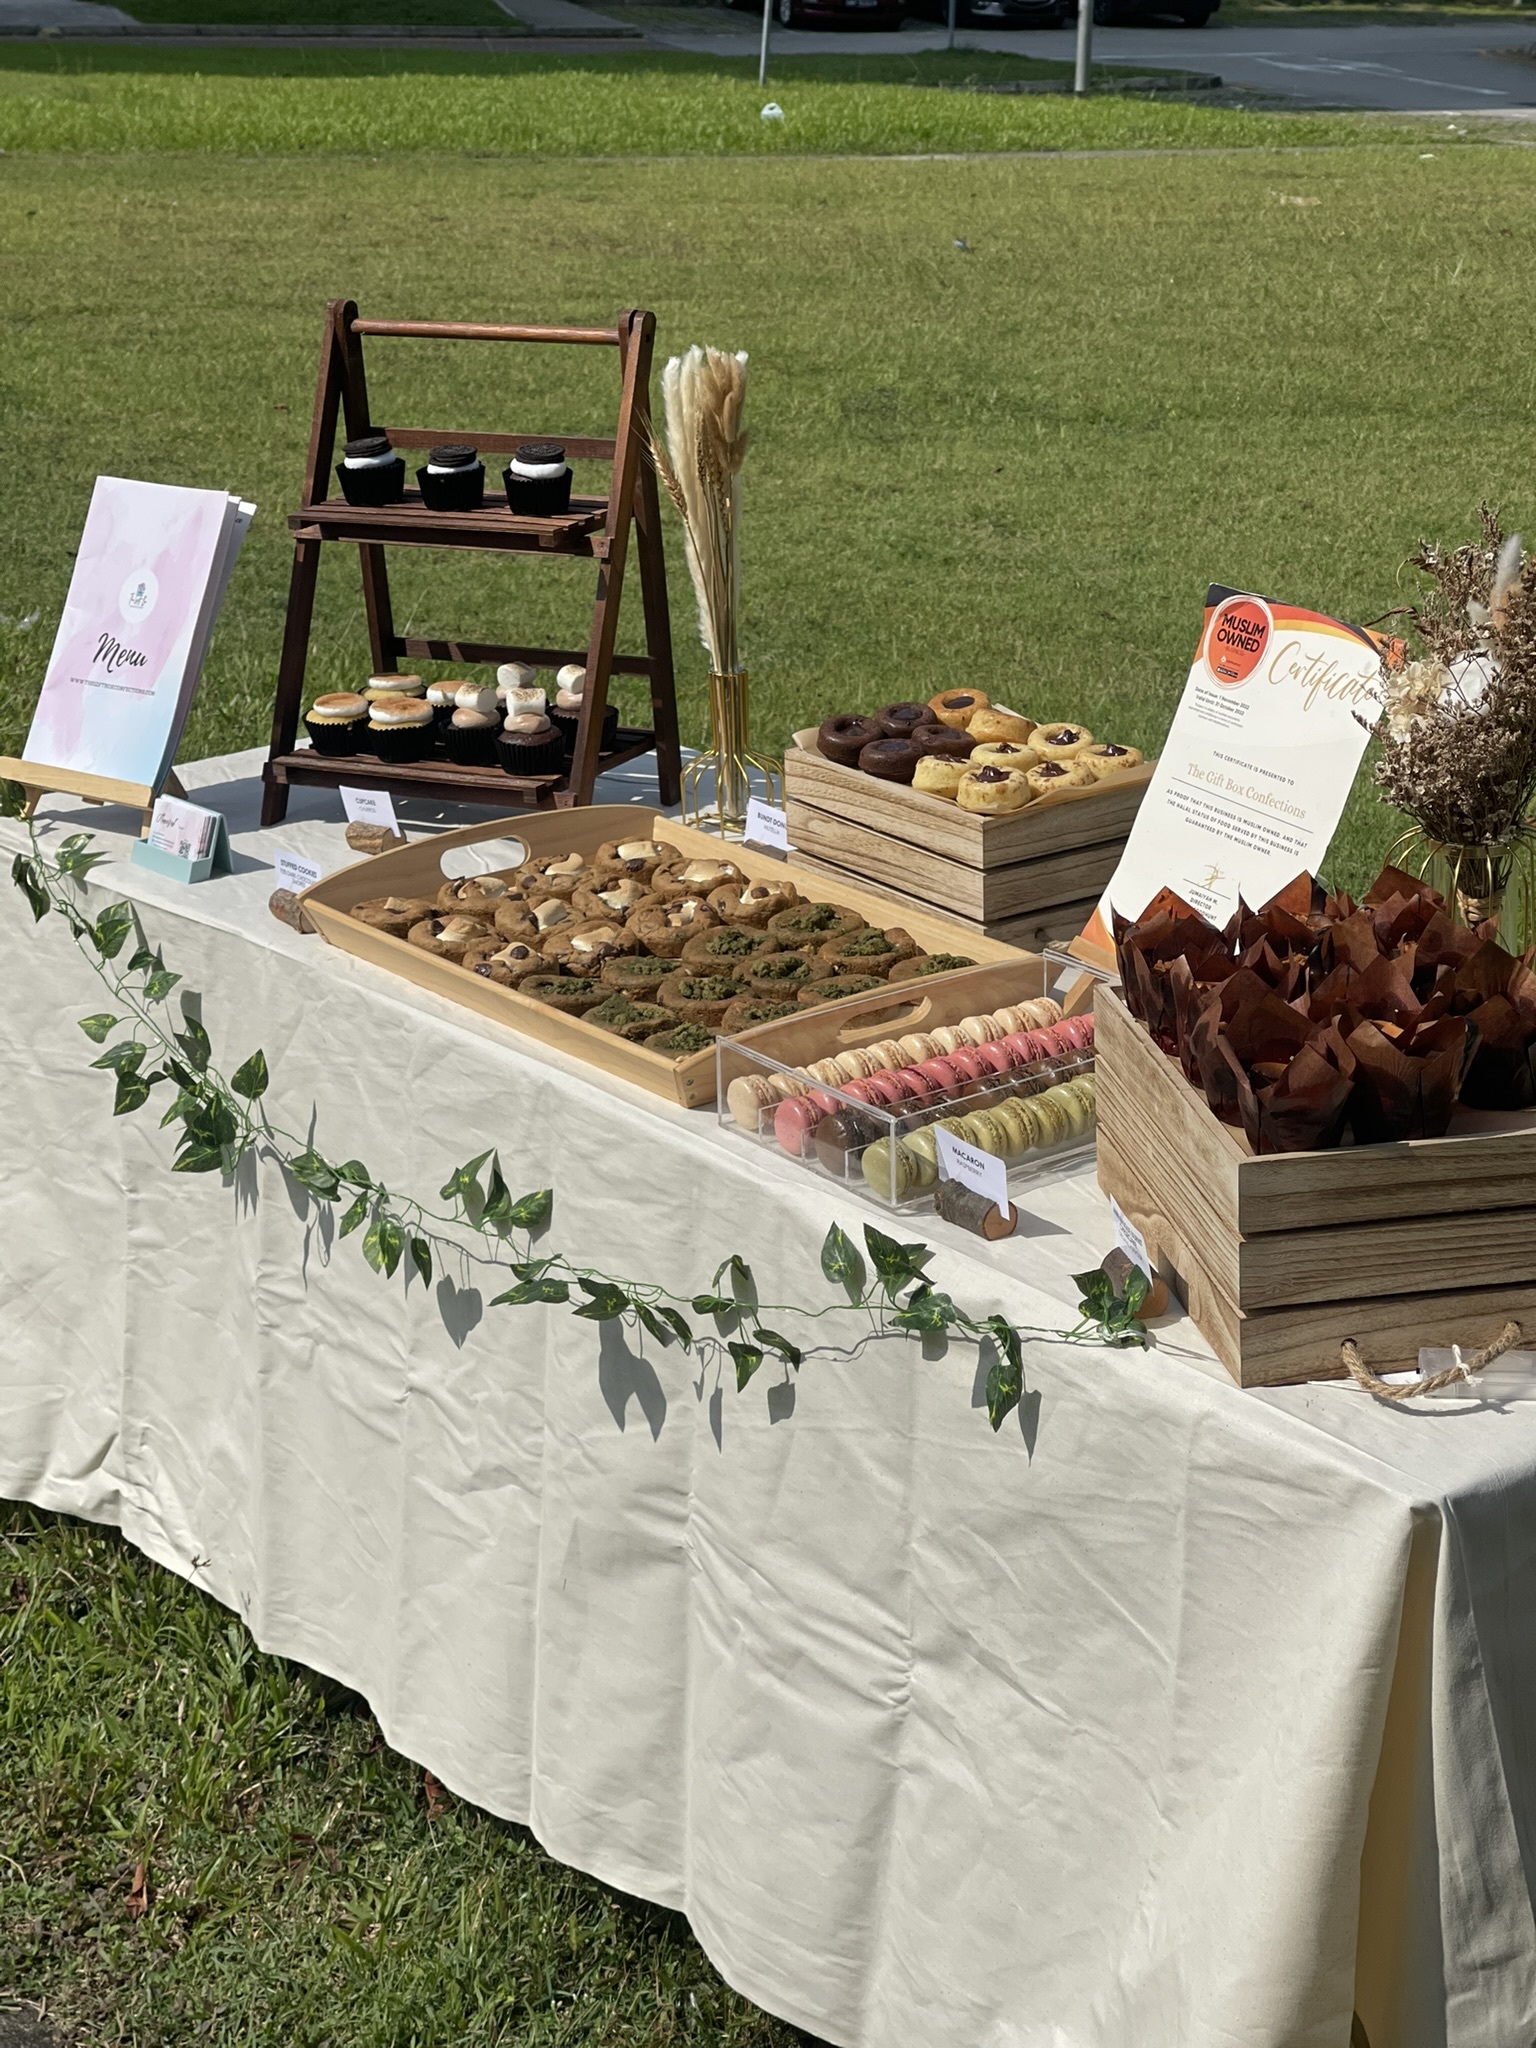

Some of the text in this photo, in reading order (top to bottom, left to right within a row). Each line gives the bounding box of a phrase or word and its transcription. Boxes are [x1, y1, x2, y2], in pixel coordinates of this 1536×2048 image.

[1221, 613, 1266, 639] MUSLIM
[92, 632, 147, 674] Menu
[1216, 628, 1260, 653] OWNED
[1213, 750, 1223, 759] THIS
[1224, 755, 1253, 770] CERTIFICATE
[1259, 768, 1286, 783] PRESENTED
[355, 797, 377, 806] CUPCAKE
[1187, 763, 1307, 819] The Gift Box Confections
[772, 818, 786, 828] DON
[1166, 799, 1176, 808] THE
[1176, 802, 1191, 813] HALAL
[1192, 808, 1210, 821] STATUS
[1217, 818, 1232, 829] FOOD
[1232, 824, 1250, 836] SERVED
[1258, 835, 1270, 844] THIS
[1269, 839, 1294, 854] BUSINESS
[1174, 791, 1190, 802] PROOF
[1190, 797, 1203, 807] THAT
[1203, 802, 1214, 811] THIS
[1214, 806, 1237, 821] BUSINESS
[1243, 819, 1262, 831] MUSLIM
[1282, 834, 1294, 844] AND
[1294, 839, 1308, 849] THAT
[1184, 817, 1216, 834] GUARANTEED
[1224, 832, 1233, 840] THE
[1234, 836, 1253, 848] MUSLIM
[1190, 898, 1212, 910] DIRECTOR
[952, 1146, 985, 1170] MACARON
